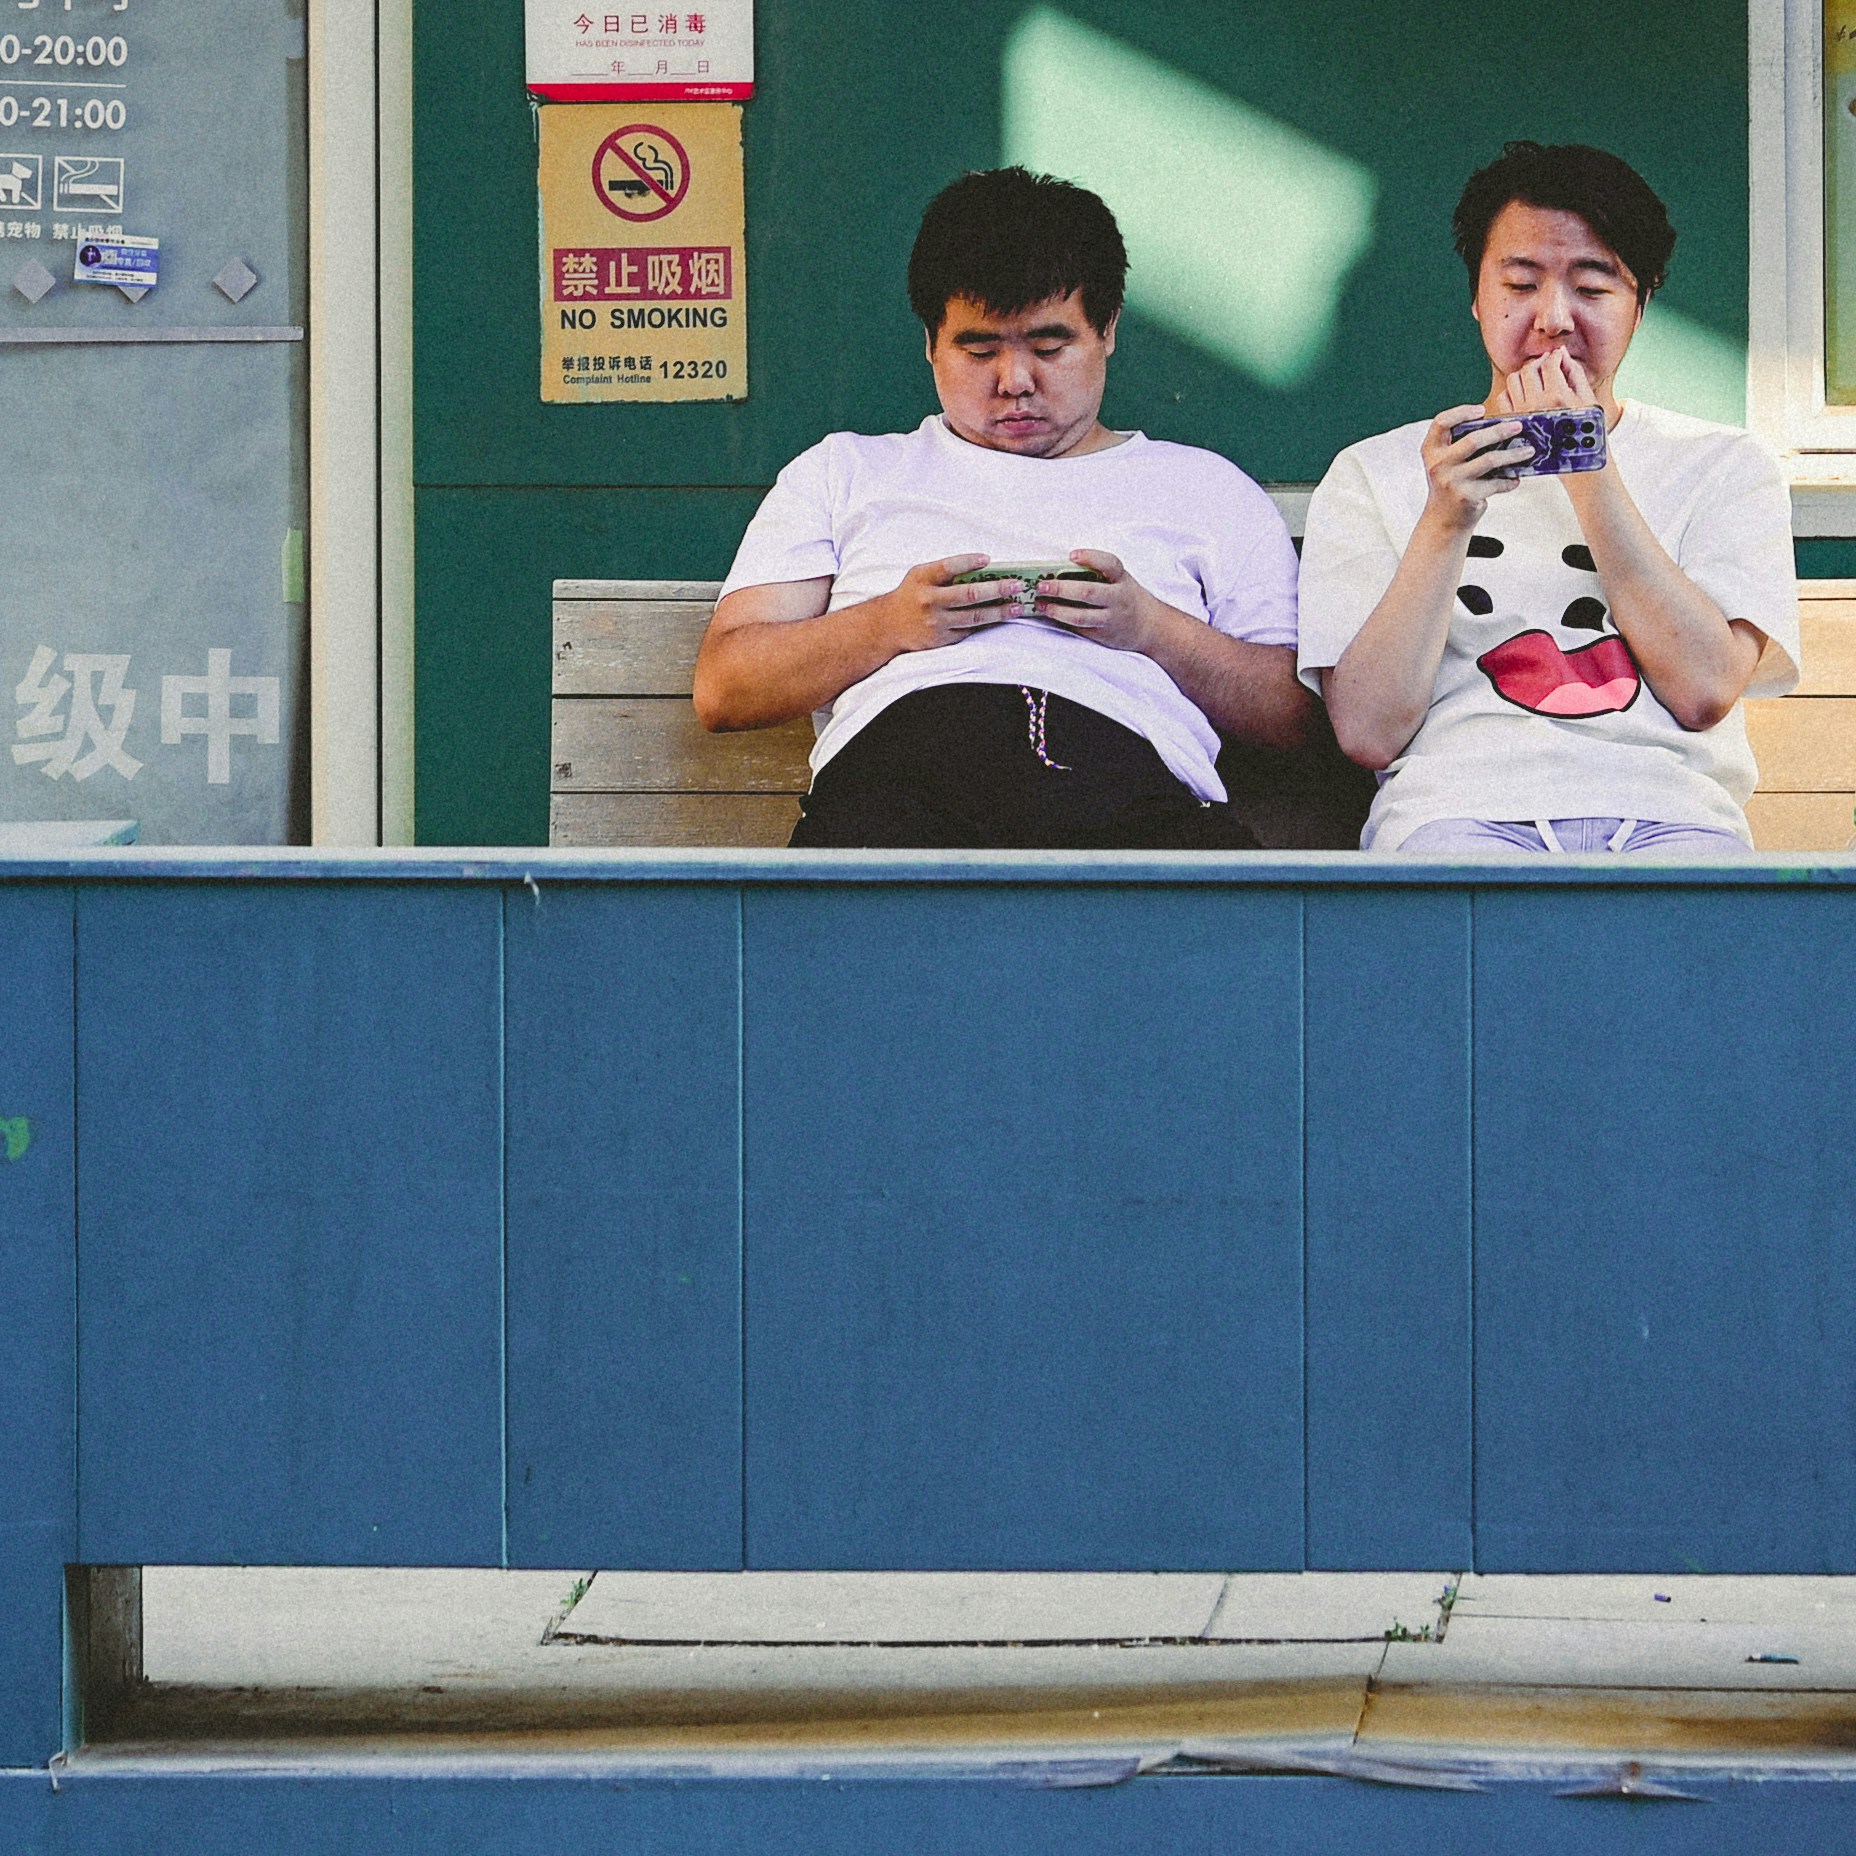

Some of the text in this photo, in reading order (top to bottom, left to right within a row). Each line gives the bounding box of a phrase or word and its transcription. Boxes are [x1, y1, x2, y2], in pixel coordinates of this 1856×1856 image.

[573, 13, 707, 34] 今日已消毒
[561, 251, 725, 297] 禁止吸烟
[561, 307, 728, 329] NO SMOKING
[561, 355, 727, 379] 举报投诉电话 12320
[563, 374, 652, 386] Complaint Hotline
